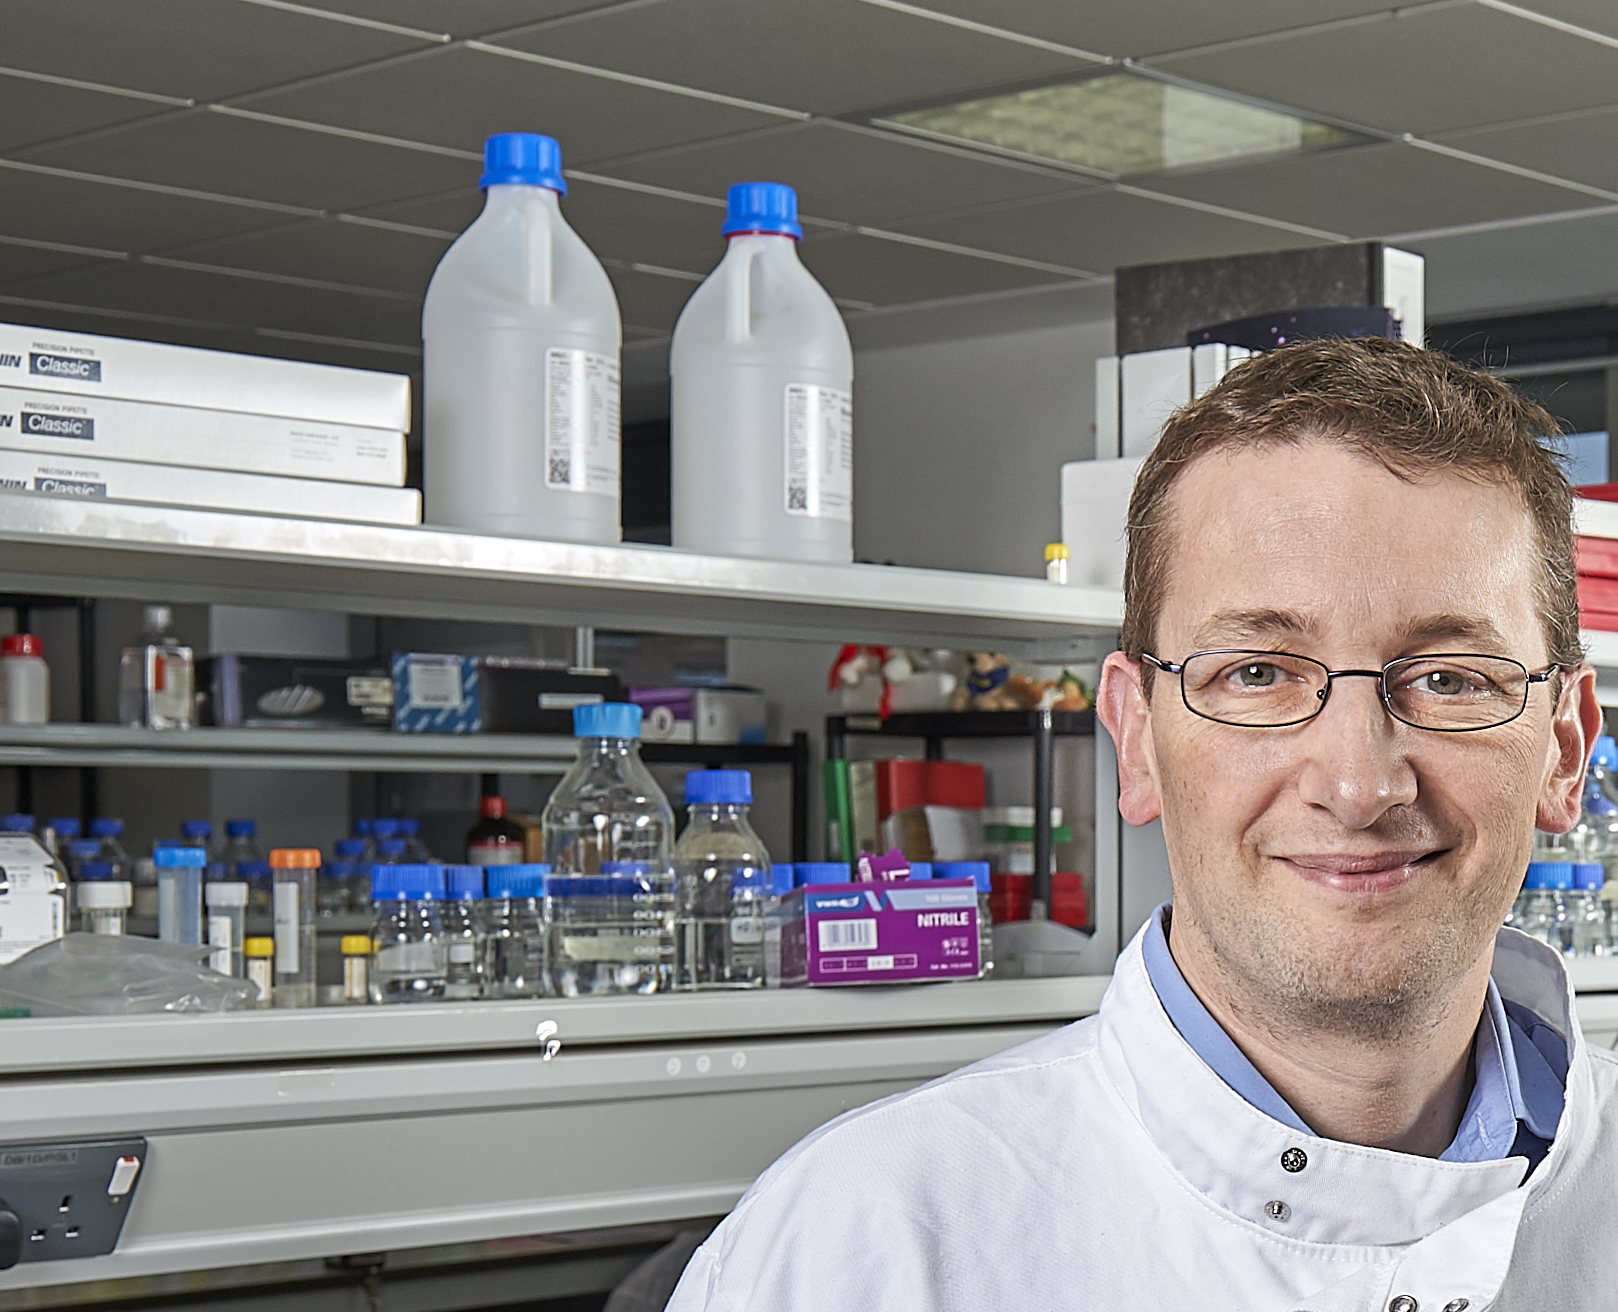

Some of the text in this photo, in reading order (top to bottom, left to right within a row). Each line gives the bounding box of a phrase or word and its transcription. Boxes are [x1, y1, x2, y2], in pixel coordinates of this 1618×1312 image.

[32, 341, 94, 356] PRECISION PIPETTE
[37, 355, 90, 377] Classic
[24, 401, 87, 414] PRECISION PIPETTE
[28, 414, 83, 435] Classic
[917, 911, 969, 928] NITRILE
